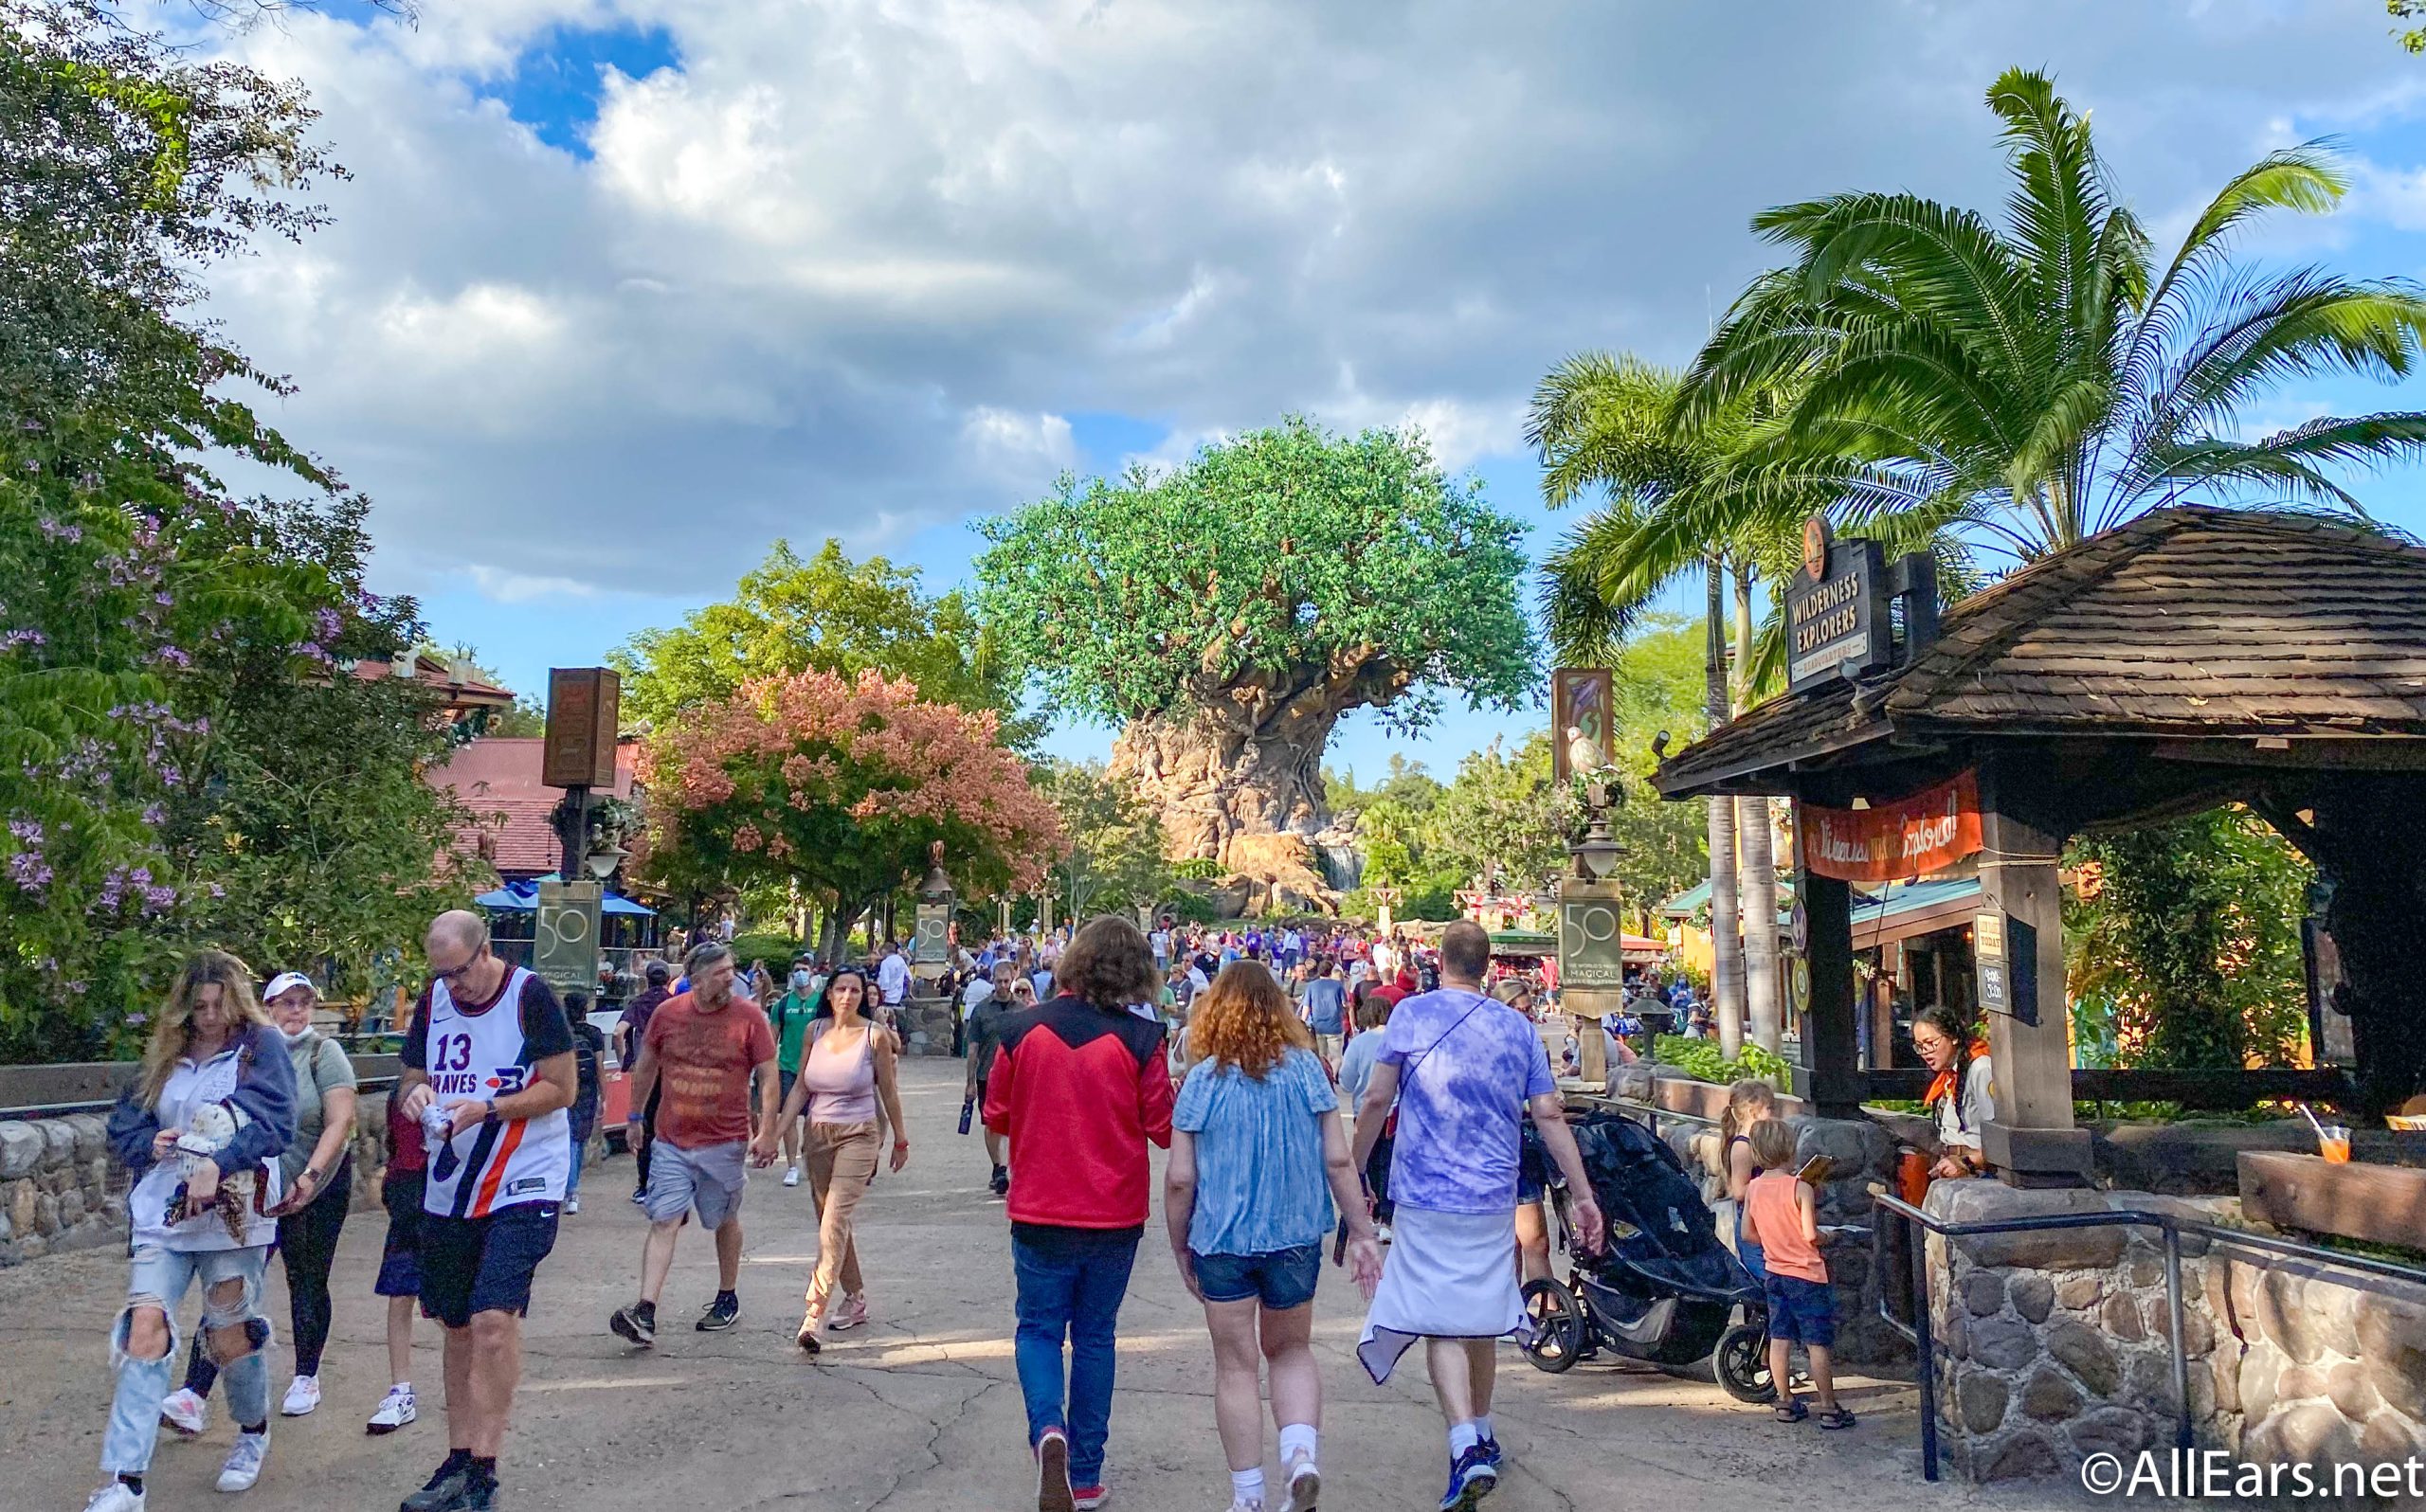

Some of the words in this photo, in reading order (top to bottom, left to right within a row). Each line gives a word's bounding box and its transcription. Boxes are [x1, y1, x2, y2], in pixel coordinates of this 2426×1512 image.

[1792, 571, 1859, 627] WILDERNESS
[1797, 604, 1857, 654] EXPLORERS
[541, 906, 588, 959] 50
[920, 918, 945, 947] 50
[1566, 904, 1616, 958] 50
[1981, 936, 2001, 948] TODAY
[1570, 969, 1616, 979] MAGICAL
[434, 1033, 472, 1071] 13
